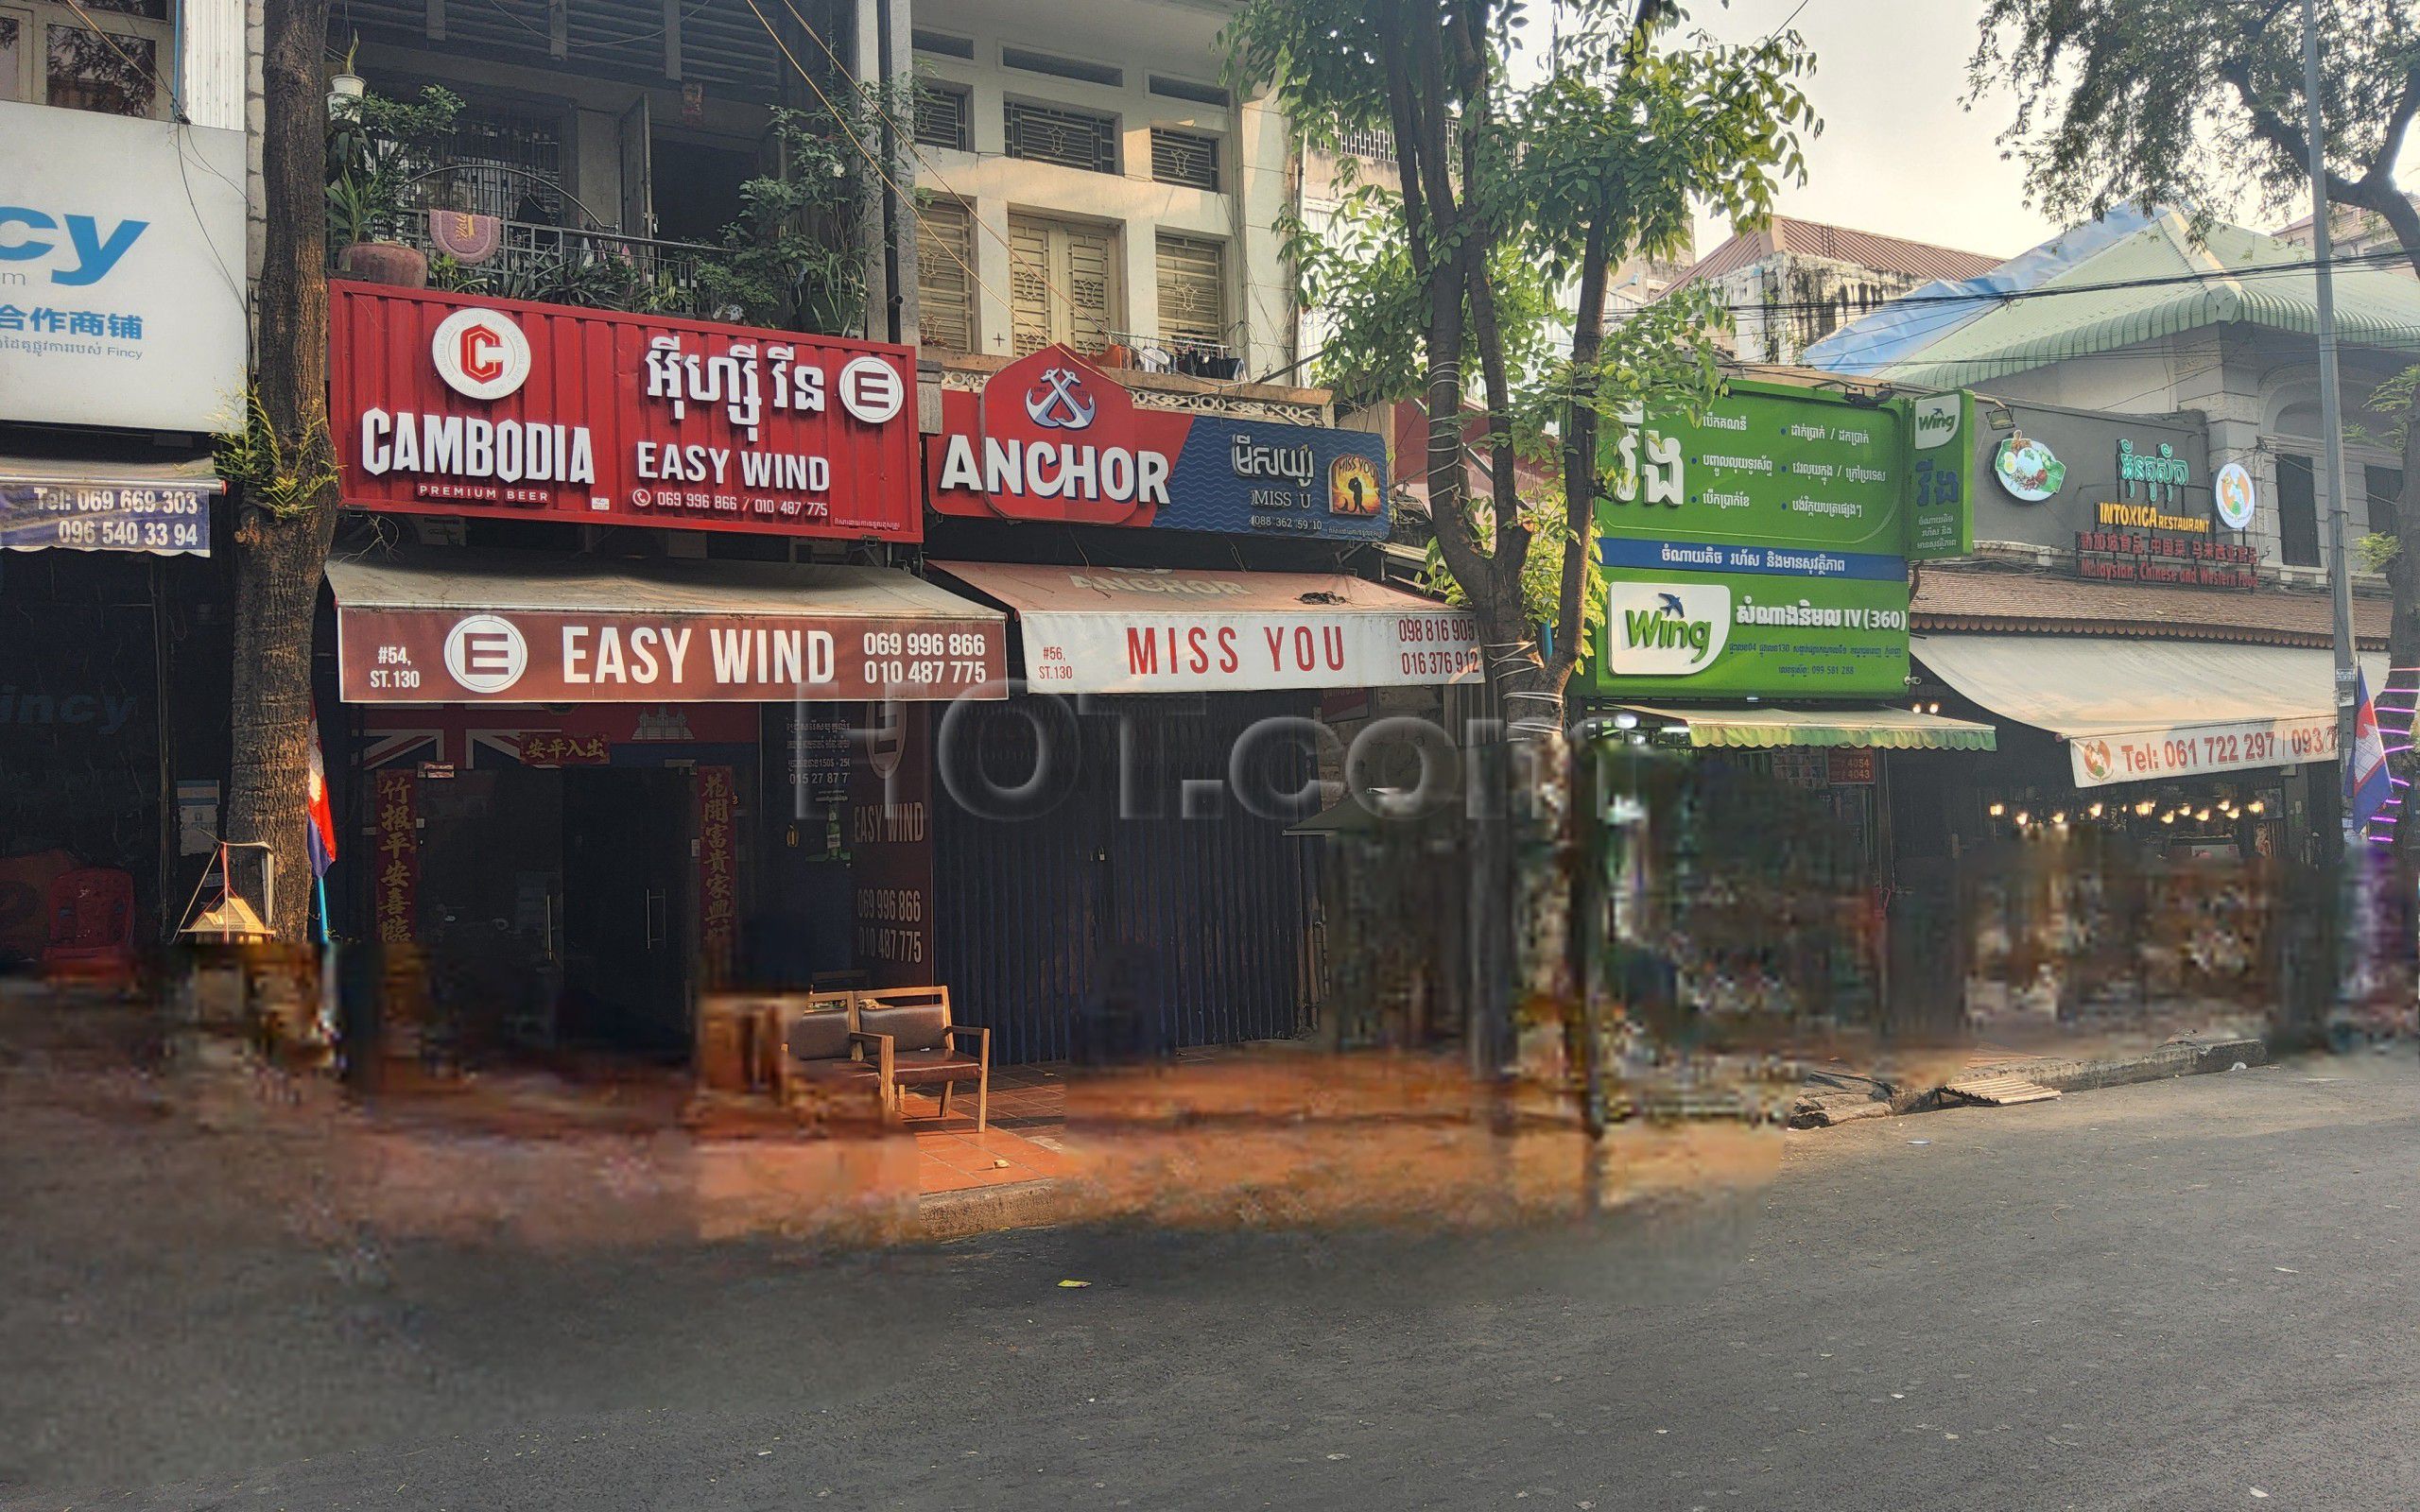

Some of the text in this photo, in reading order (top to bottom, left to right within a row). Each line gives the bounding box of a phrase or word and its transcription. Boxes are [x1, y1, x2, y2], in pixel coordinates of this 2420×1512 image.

[107, 347, 143, 361] Fincy
[1918, 414, 1956, 433] Wing
[362, 407, 596, 485] CAMBODIA
[637, 441, 830, 492] EASY WIND
[940, 434, 1170, 506] ANCHOR
[1340, 456, 1375, 480] MISS YOU
[34, 488, 198, 515] Tel: 069 669 303
[418, 484, 550, 504] PREMIUM BEER
[657, 491, 682, 507] 069
[685, 492, 709, 508] 996
[715, 494, 737, 510] 866
[754, 498, 774, 513] 010
[779, 500, 802, 515] 487
[807, 501, 828, 517] 775
[1253, 490, 1311, 508] MISS U
[1253, 516, 1322, 529] 088 362 59 10
[2100, 502, 2157, 528] INTOXICA
[2158, 515, 2210, 534] RESTAURANT
[58, 521, 198, 546] 096 540 33 94
[2139, 560, 2176, 582] Chinese
[2180, 566, 2196, 583] and
[2200, 567, 2236, 586] Western
[1398, 619, 1475, 643] 098 816 905
[1843, 609, 1862, 627] IV
[1863, 609, 1906, 631] (360)
[863, 631, 985, 657] 069 996 866
[1626, 610, 1712, 663] Wing
[377, 646, 412, 667] #54,
[562, 626, 835, 684] EASY WIND
[1043, 646, 1066, 662] #56,
[1127, 625, 1345, 675] MISS YOU
[864, 660, 986, 685] 010 487 775
[1038, 665, 1073, 680] ST.130
[1401, 651, 1479, 676] 016 376 912
[371, 668, 420, 689] ST.130
[2121, 744, 2159, 773] Tel:
[2164, 740, 2198, 768] 061
[2204, 735, 2238, 765] 722
[2243, 731, 2275, 762] 297
[811, 773, 823, 784] 27
[827, 772, 838, 784] 87
[855, 801, 925, 843] EASY WIND
[857, 888, 922, 922] 069 996 866
[859, 926, 923, 964] 010 487 775
